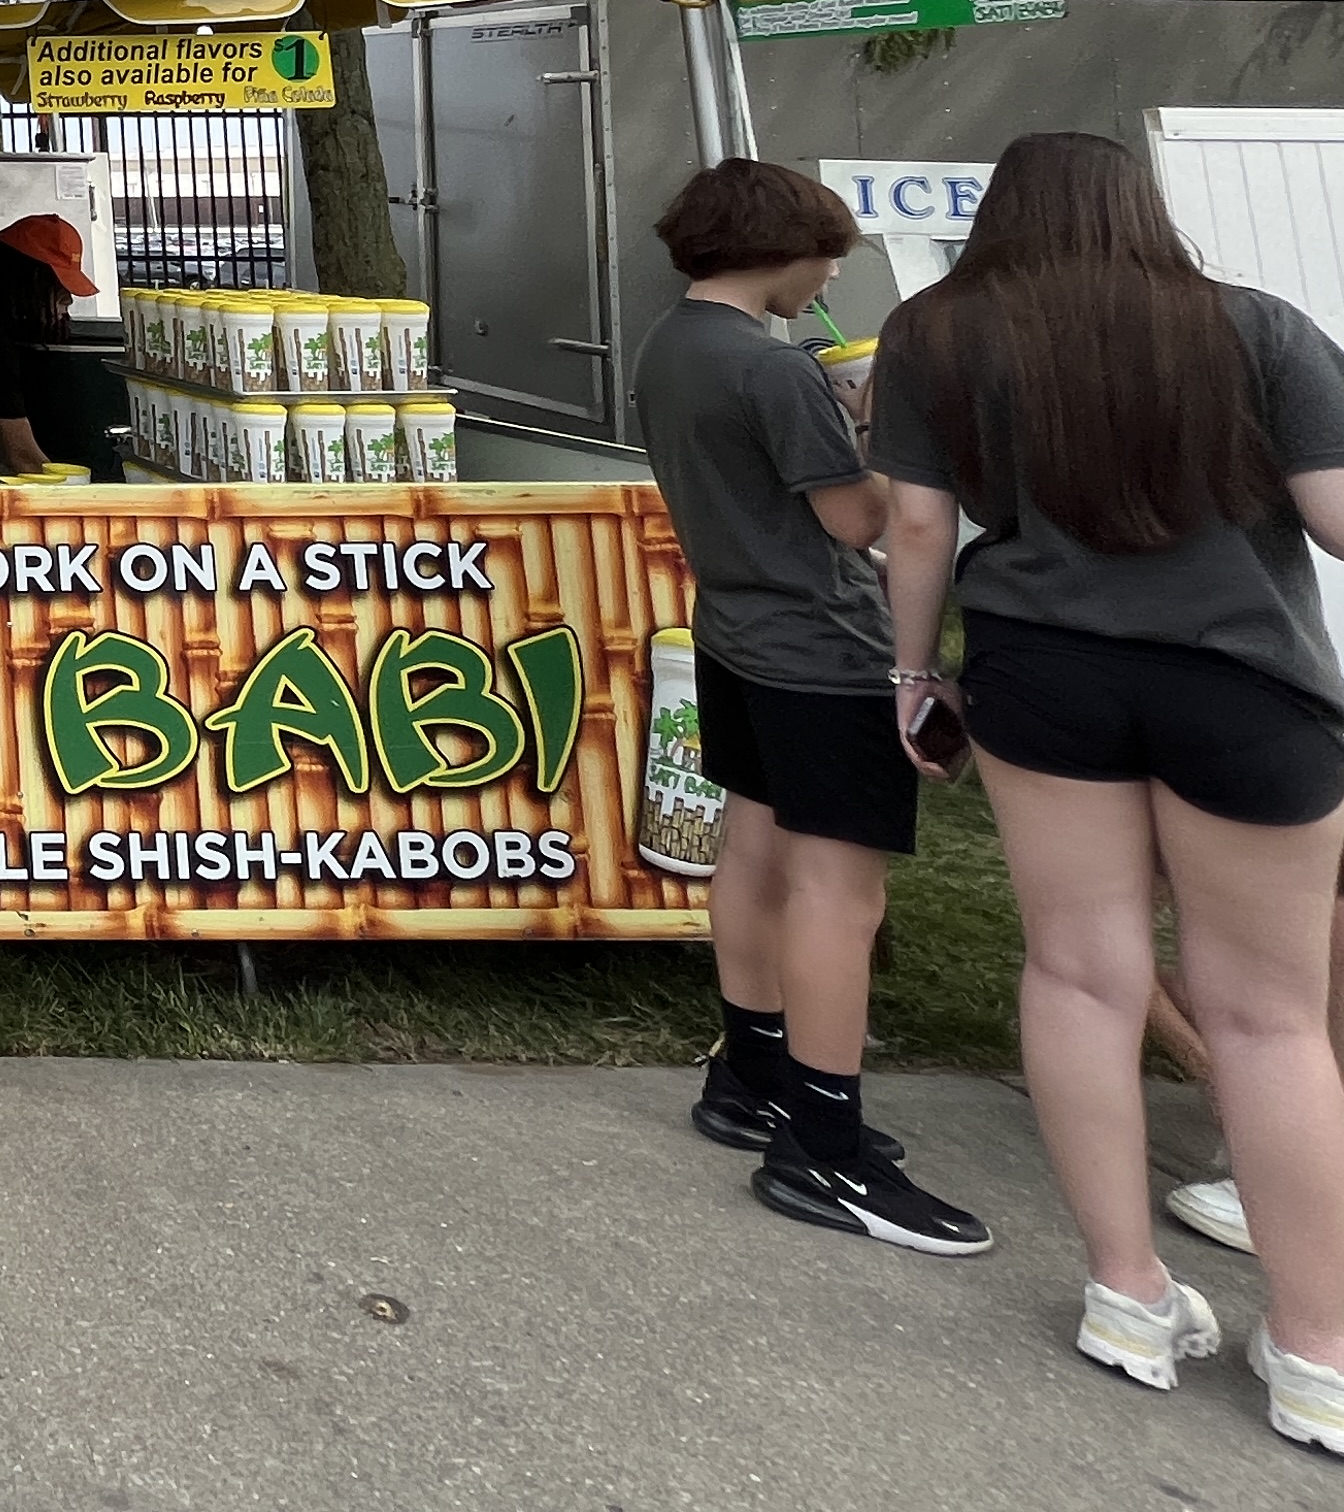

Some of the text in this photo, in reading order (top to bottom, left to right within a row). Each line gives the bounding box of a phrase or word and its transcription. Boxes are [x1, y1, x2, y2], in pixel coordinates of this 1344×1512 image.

[472, 23, 562, 39] STEALTH
[37, 38, 316, 80] Additional flavors $1
[39, 62, 258, 86] also available for
[37, 92, 127, 110] Strawberry
[145, 91, 225, 107] Raspberry
[852, 174, 983, 220] ICE
[120, 543, 216, 593] ON
[237, 543, 286, 592] A
[304, 542, 495, 592] STICK
[43, 626, 582, 795] BABI
[89, 830, 574, 882] SHISH-KABOBS
